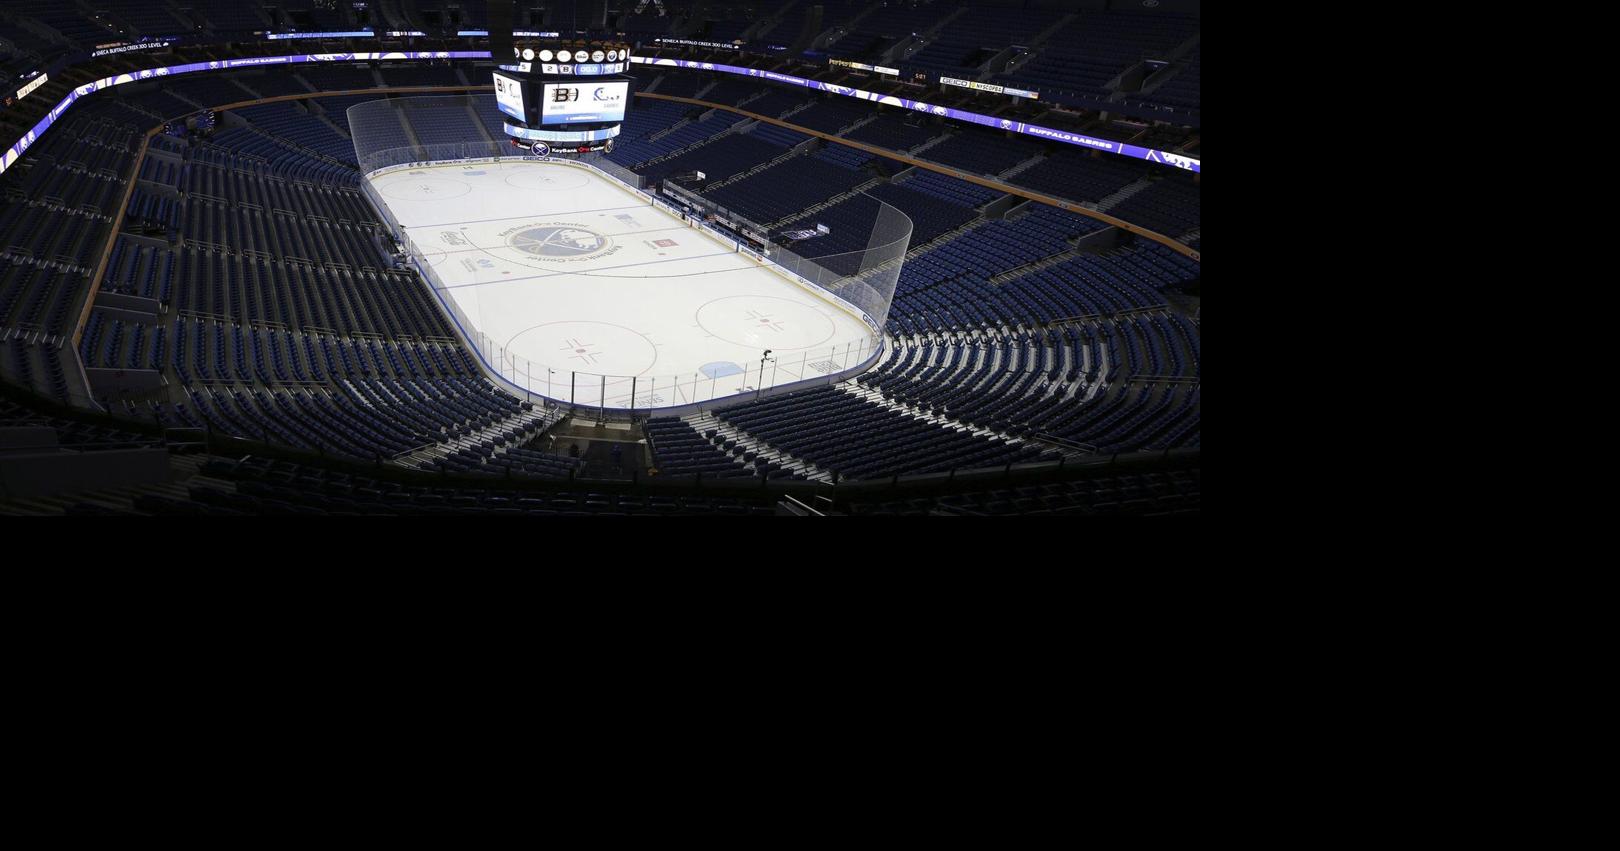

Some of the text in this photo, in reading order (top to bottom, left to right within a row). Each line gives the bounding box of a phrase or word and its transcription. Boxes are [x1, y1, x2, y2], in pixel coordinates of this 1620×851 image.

[942, 78, 969, 86] GEICO
[1028, 127, 1112, 149] BUFFALO SABRES
